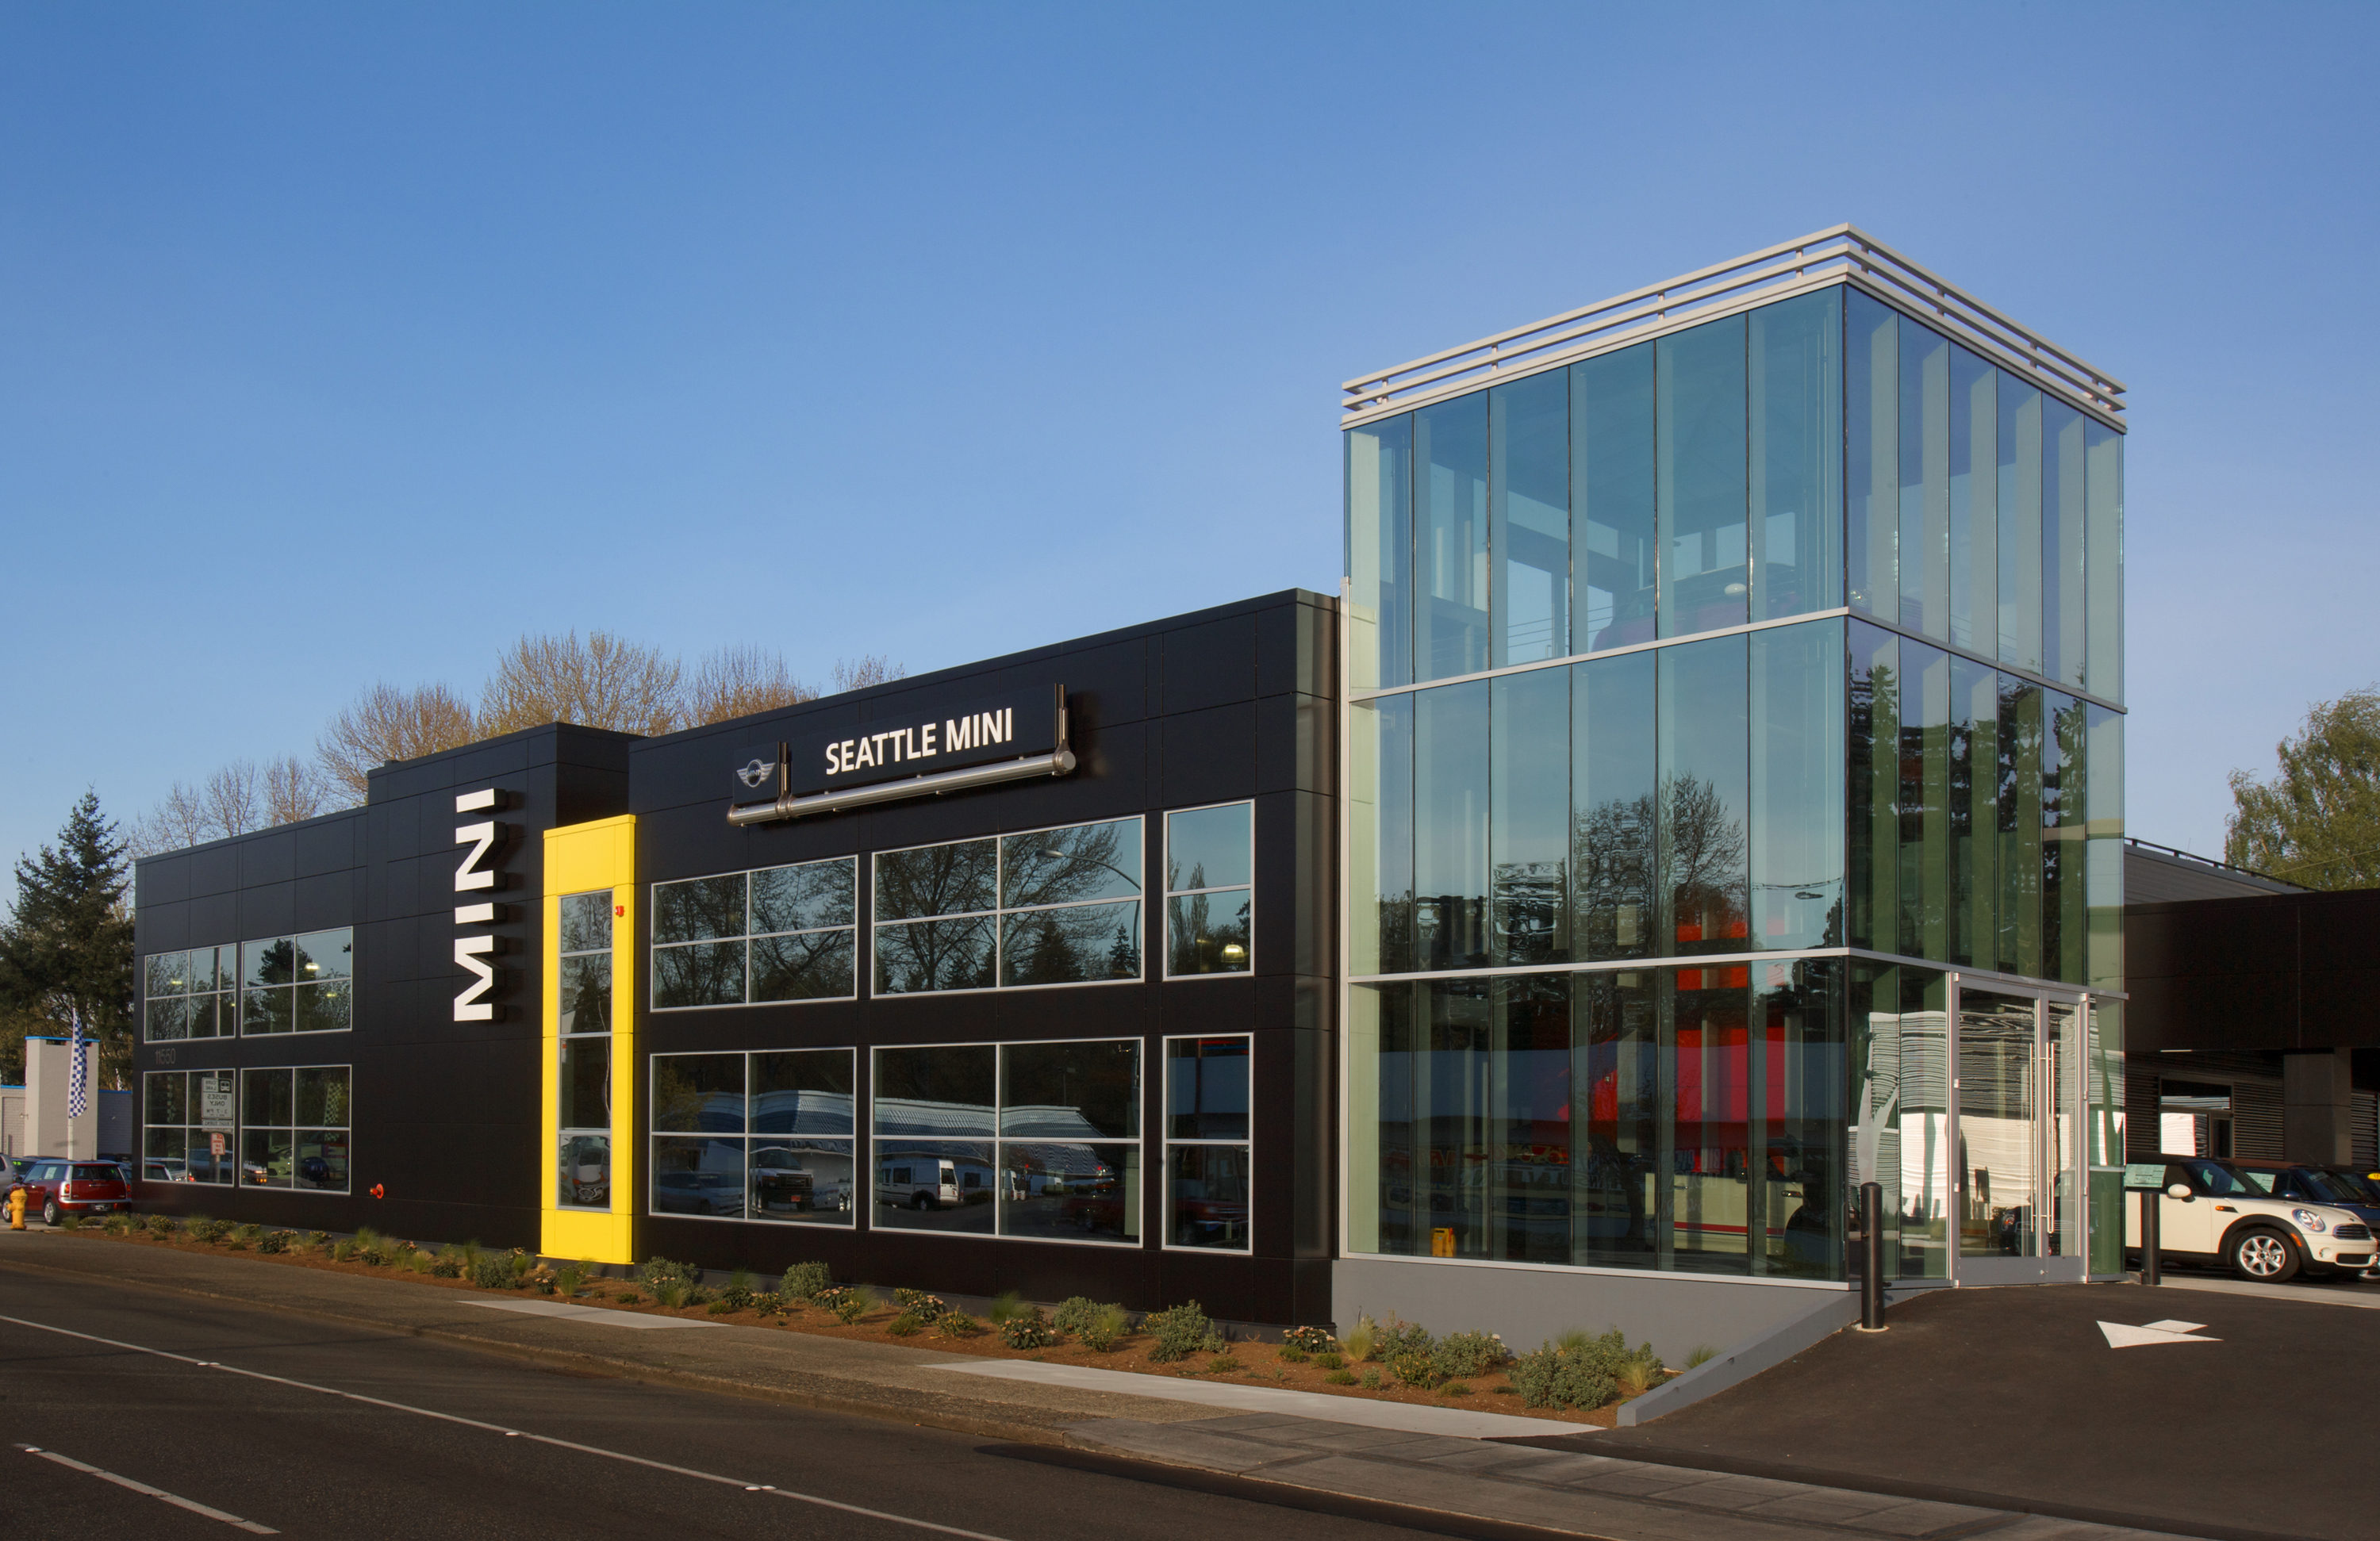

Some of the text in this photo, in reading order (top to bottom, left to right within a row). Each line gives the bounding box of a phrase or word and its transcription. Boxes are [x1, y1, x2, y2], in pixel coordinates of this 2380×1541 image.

[826, 707, 1012, 775] SEATTLE MINI
[454, 788, 494, 1022] MINI
[155, 1048, 176, 1064] 11550
